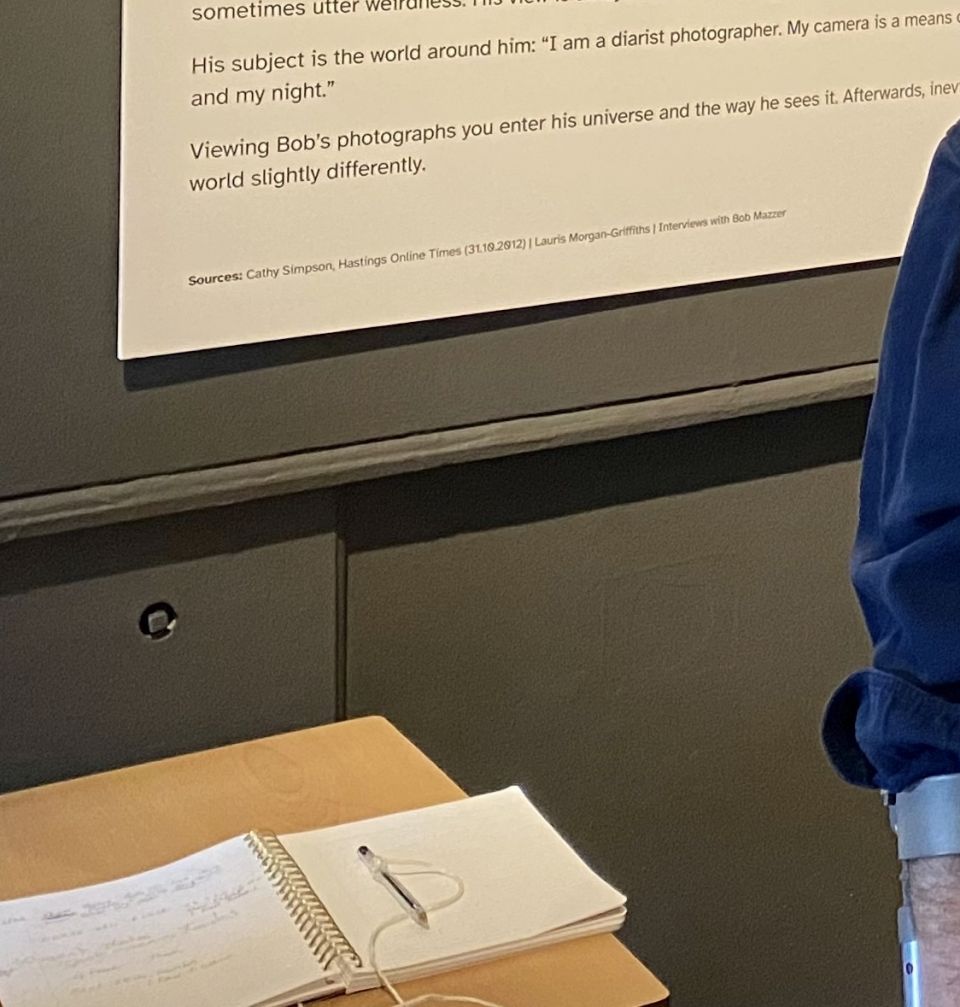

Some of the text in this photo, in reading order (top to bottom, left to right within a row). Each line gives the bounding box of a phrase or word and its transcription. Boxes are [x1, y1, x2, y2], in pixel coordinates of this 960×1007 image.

[191, 0, 306, 21] sometimes
[190, 86, 229, 107] and
[235, 88, 266, 106] my
[189, 137, 270, 160] Viewing
[337, 123, 457, 152] photographs
[461, 121, 493, 141] you
[498, 117, 547, 134] enter
[551, 111, 577, 129] his
[582, 108, 654, 127] universe
[658, 102, 690, 120] and
[694, 100, 721, 117] the
[725, 99, 756, 116] way
[760, 95, 780, 111] he
[783, 94, 820, 109] sees
[824, 89, 839, 105] it.
[842, 82, 925, 104] Afterwards,
[188, 155, 426, 192] world slightly differently.
[187, 209, 787, 287] Sources: Cathy Simpson, Hastings Online Times (31.10.2012) Lauris Morgan-Griffiths Interviews with Bob Mazzer
